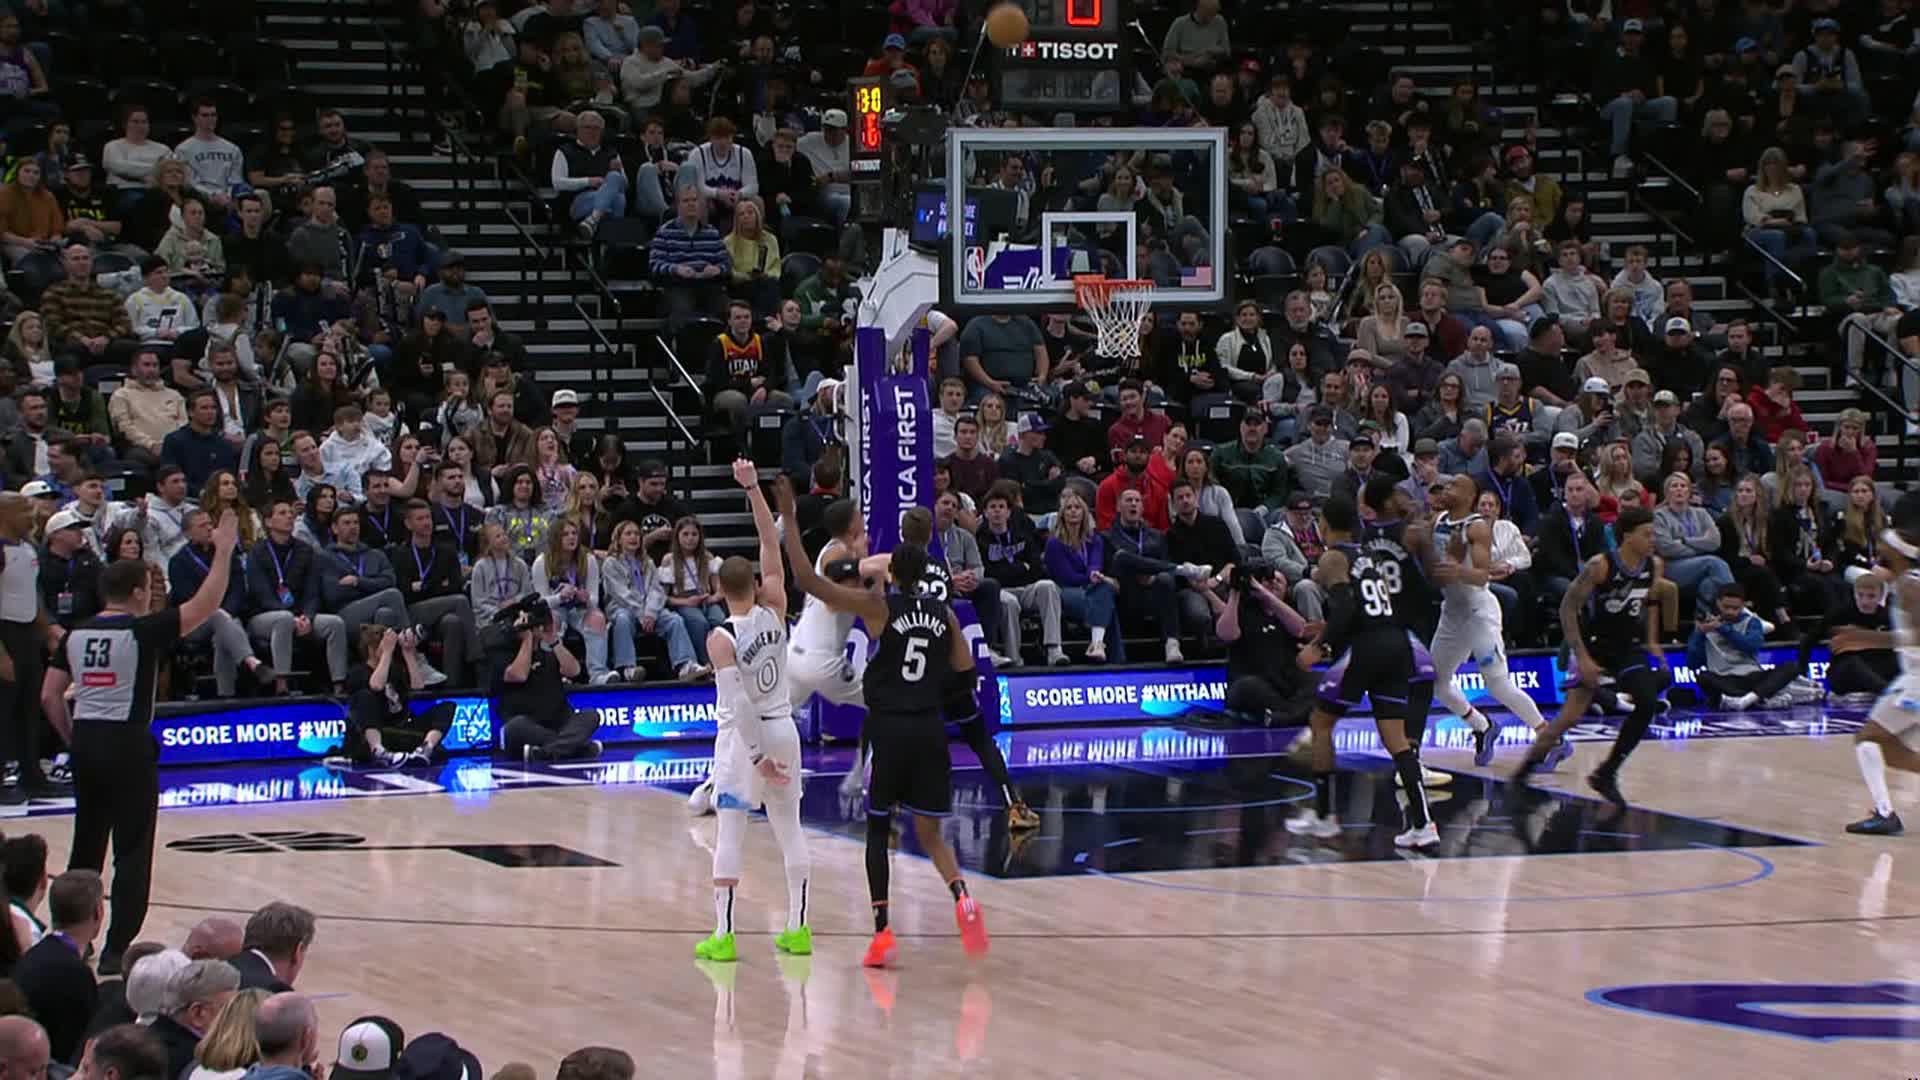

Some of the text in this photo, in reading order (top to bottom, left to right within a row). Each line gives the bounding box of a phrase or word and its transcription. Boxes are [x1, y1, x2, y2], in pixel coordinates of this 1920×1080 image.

[1038, 42, 1118, 59] TISSOT
[861, 388, 872, 465] FIRST
[894, 384, 917, 462] FIRST
[1361, 579, 1393, 616] 99
[1628, 599, 1642, 616] 3
[891, 611, 947, 638] WILLIAMS
[84, 637, 112, 668] 53
[901, 636, 929, 682] 5
[756, 656, 779, 695] 0
[1026, 688, 1083, 707] SCORE
[1087, 686, 1138, 705] MORE
[1141, 682, 1228, 700] #WITHAM
[162, 725, 232, 746] SCORE
[236, 722, 295, 743] MORE
